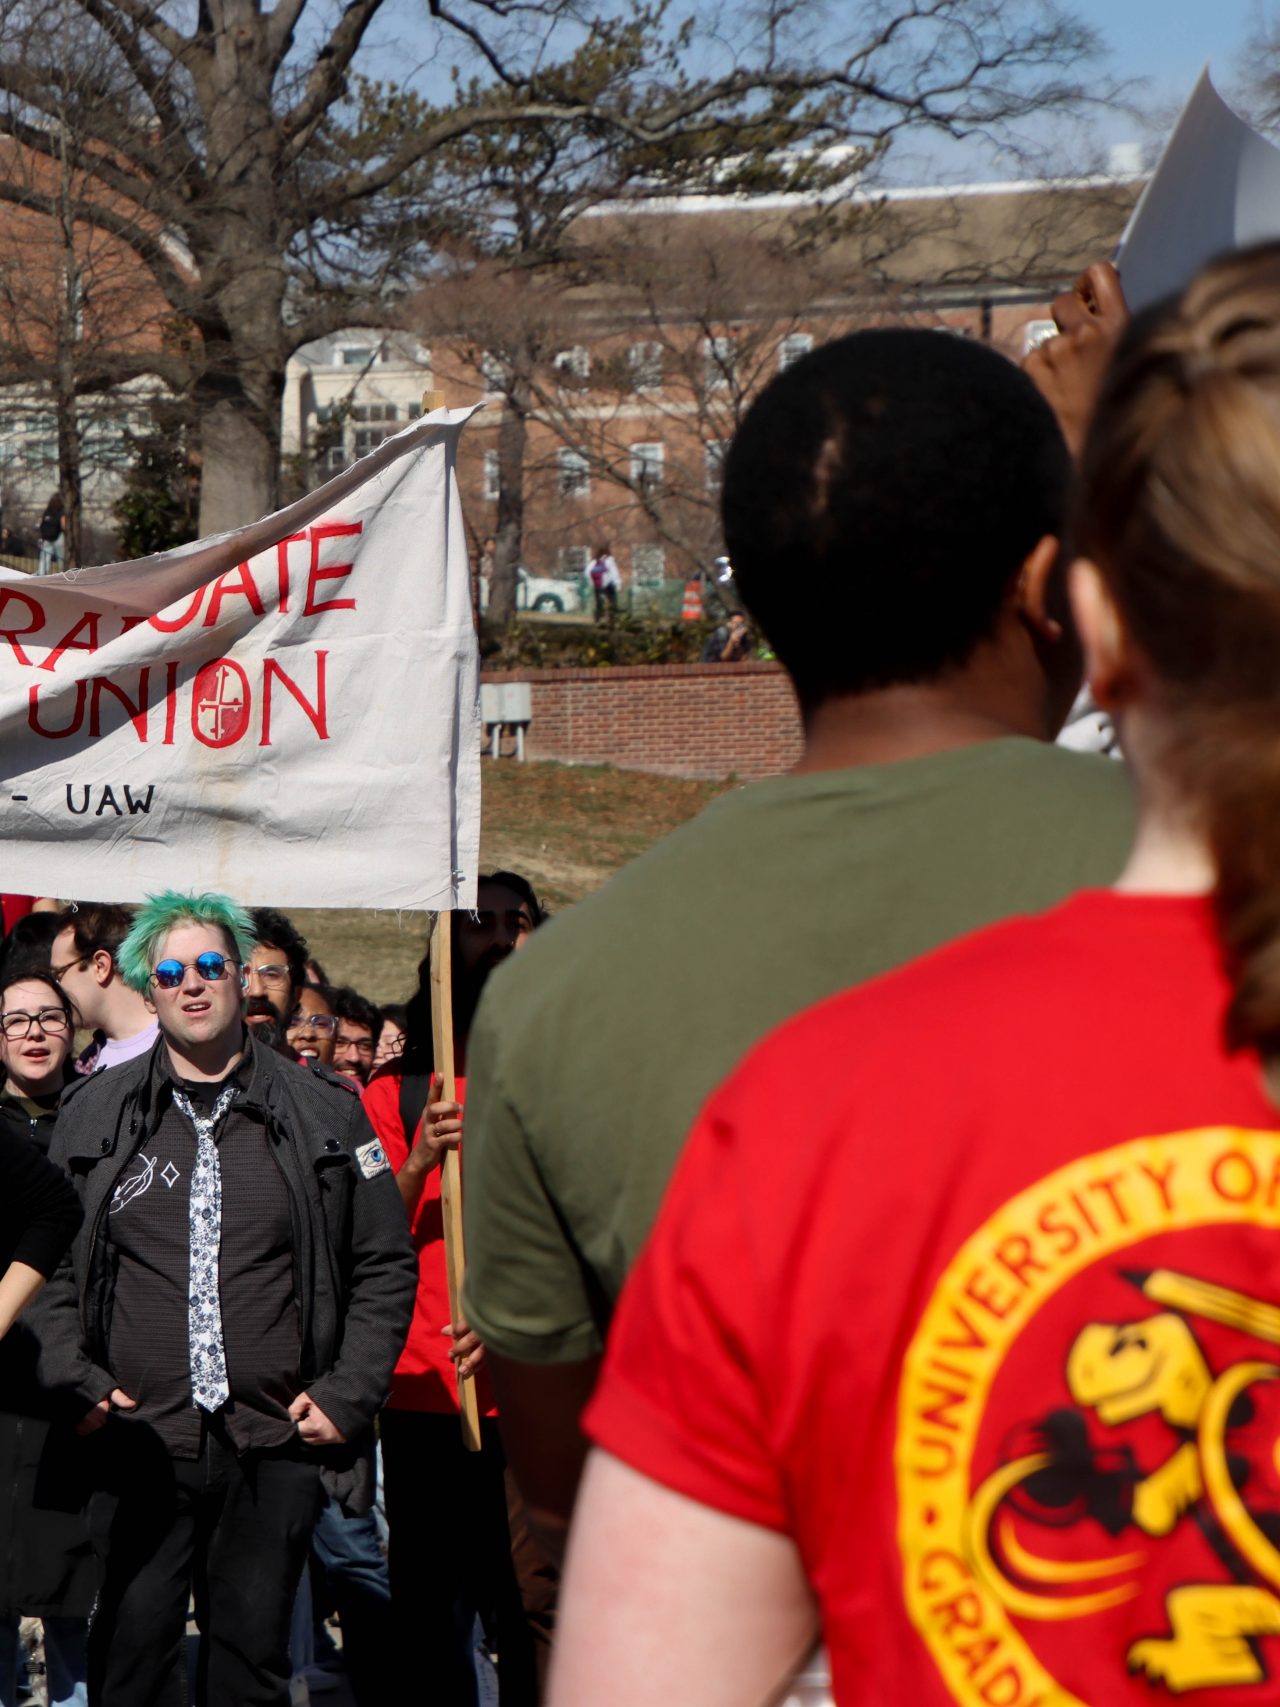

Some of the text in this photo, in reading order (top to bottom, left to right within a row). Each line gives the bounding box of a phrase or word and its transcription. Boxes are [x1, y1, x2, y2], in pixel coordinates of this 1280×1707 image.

[27, 648, 332, 749] UNION
[65, 783, 155, 816] UAW
[914, 1155, 1178, 1480] UNIVERSITY
[918, 1545, 1045, 1707] GRAD
